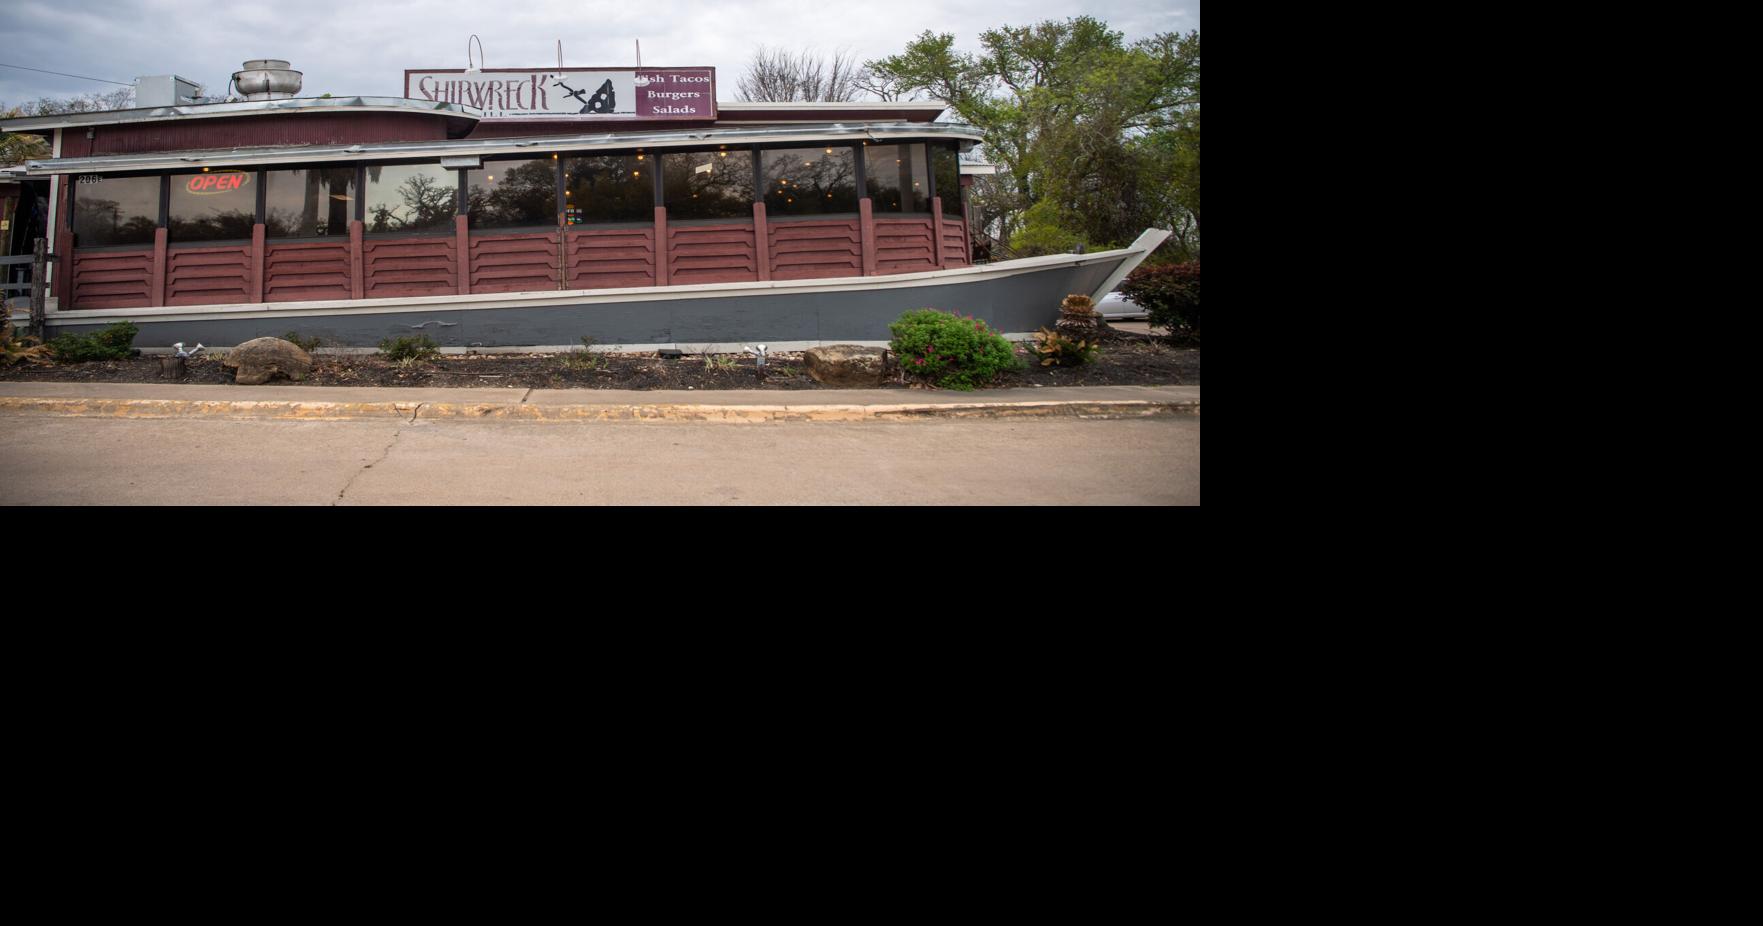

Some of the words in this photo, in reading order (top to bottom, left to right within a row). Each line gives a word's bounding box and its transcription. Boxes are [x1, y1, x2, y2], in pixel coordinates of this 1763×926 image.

[669, 75, 710, 83] Tacos
[418, 75, 549, 110] SHIPWRECK
[647, 90, 700, 100] Burgers
[652, 105, 696, 114] Salads
[190, 175, 243, 190] OPEN
